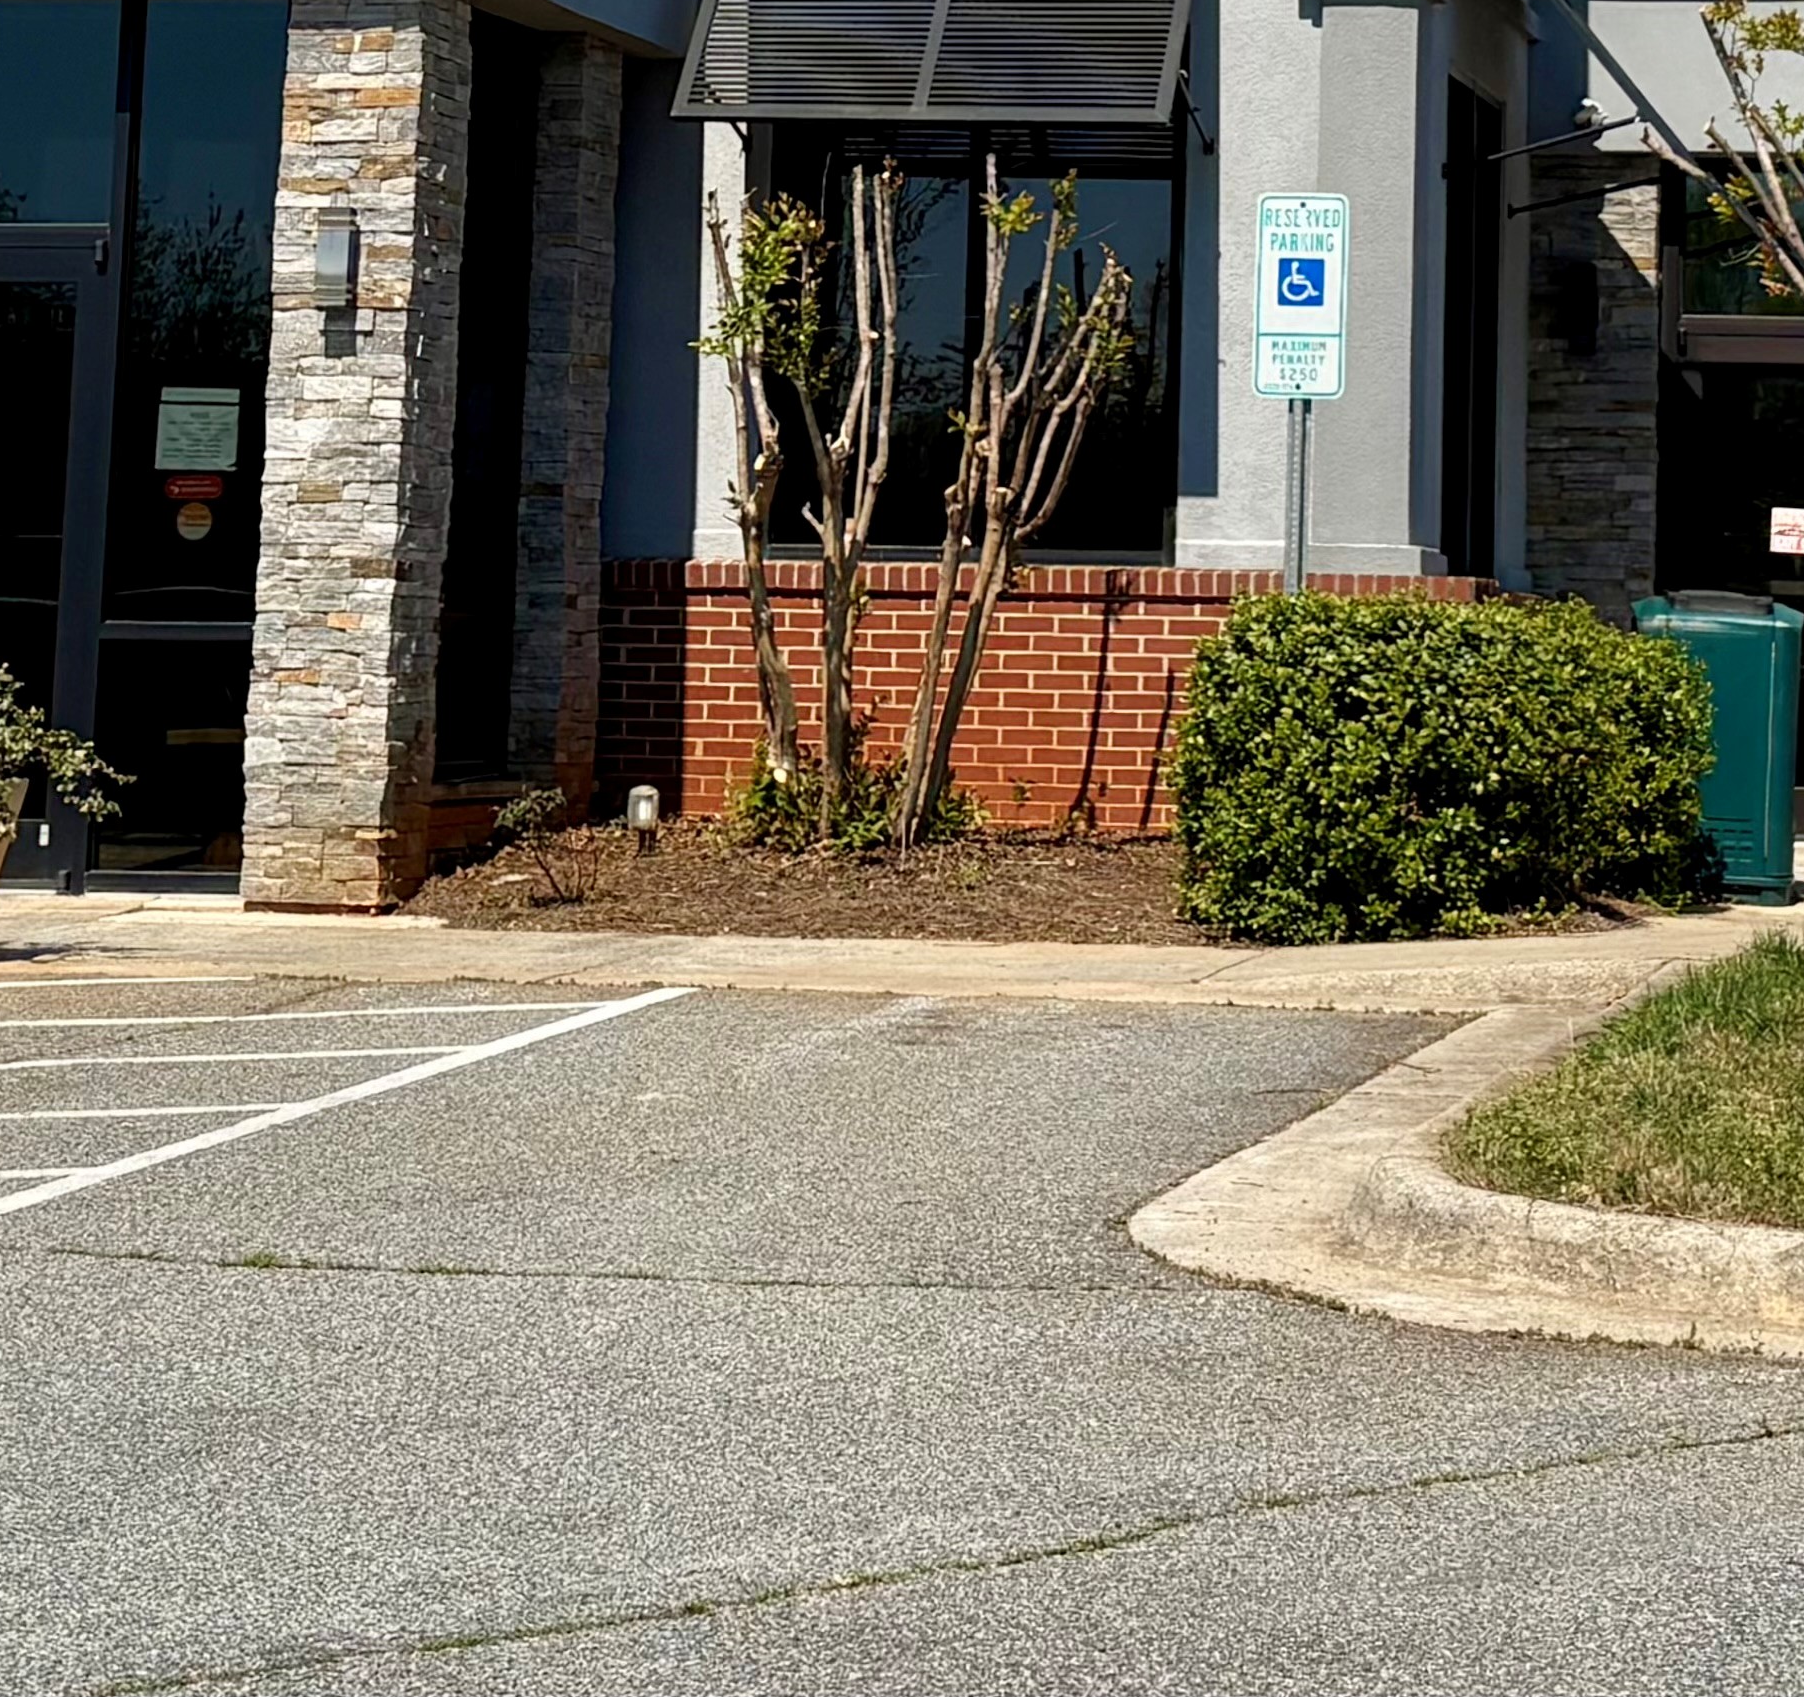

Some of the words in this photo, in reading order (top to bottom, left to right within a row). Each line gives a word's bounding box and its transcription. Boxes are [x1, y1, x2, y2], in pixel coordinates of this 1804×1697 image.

[1264, 208, 1341, 228] RESERVED
[1270, 233, 1335, 253] PARKING
[1272, 340, 1327, 352] MAXIMUM
[1272, 353, 1326, 366] PENALTY
[1279, 367, 1318, 382] $250
